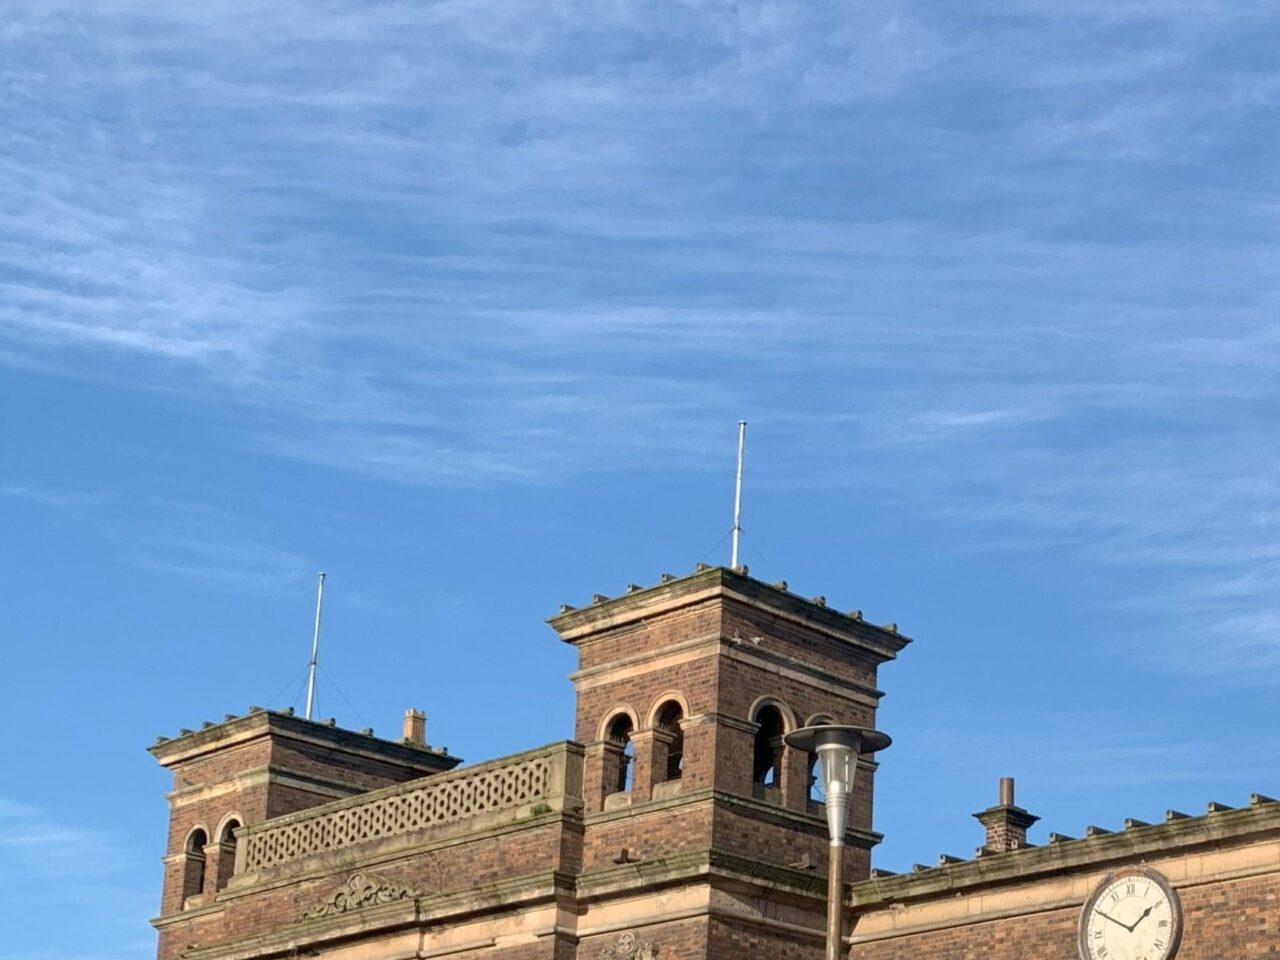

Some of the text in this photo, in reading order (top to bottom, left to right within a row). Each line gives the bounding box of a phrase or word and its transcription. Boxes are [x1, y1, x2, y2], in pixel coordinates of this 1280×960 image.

[1126, 883, 1136, 895] XII
[1110, 891, 1120, 902] XI
[1157, 920, 1168, 928] III
